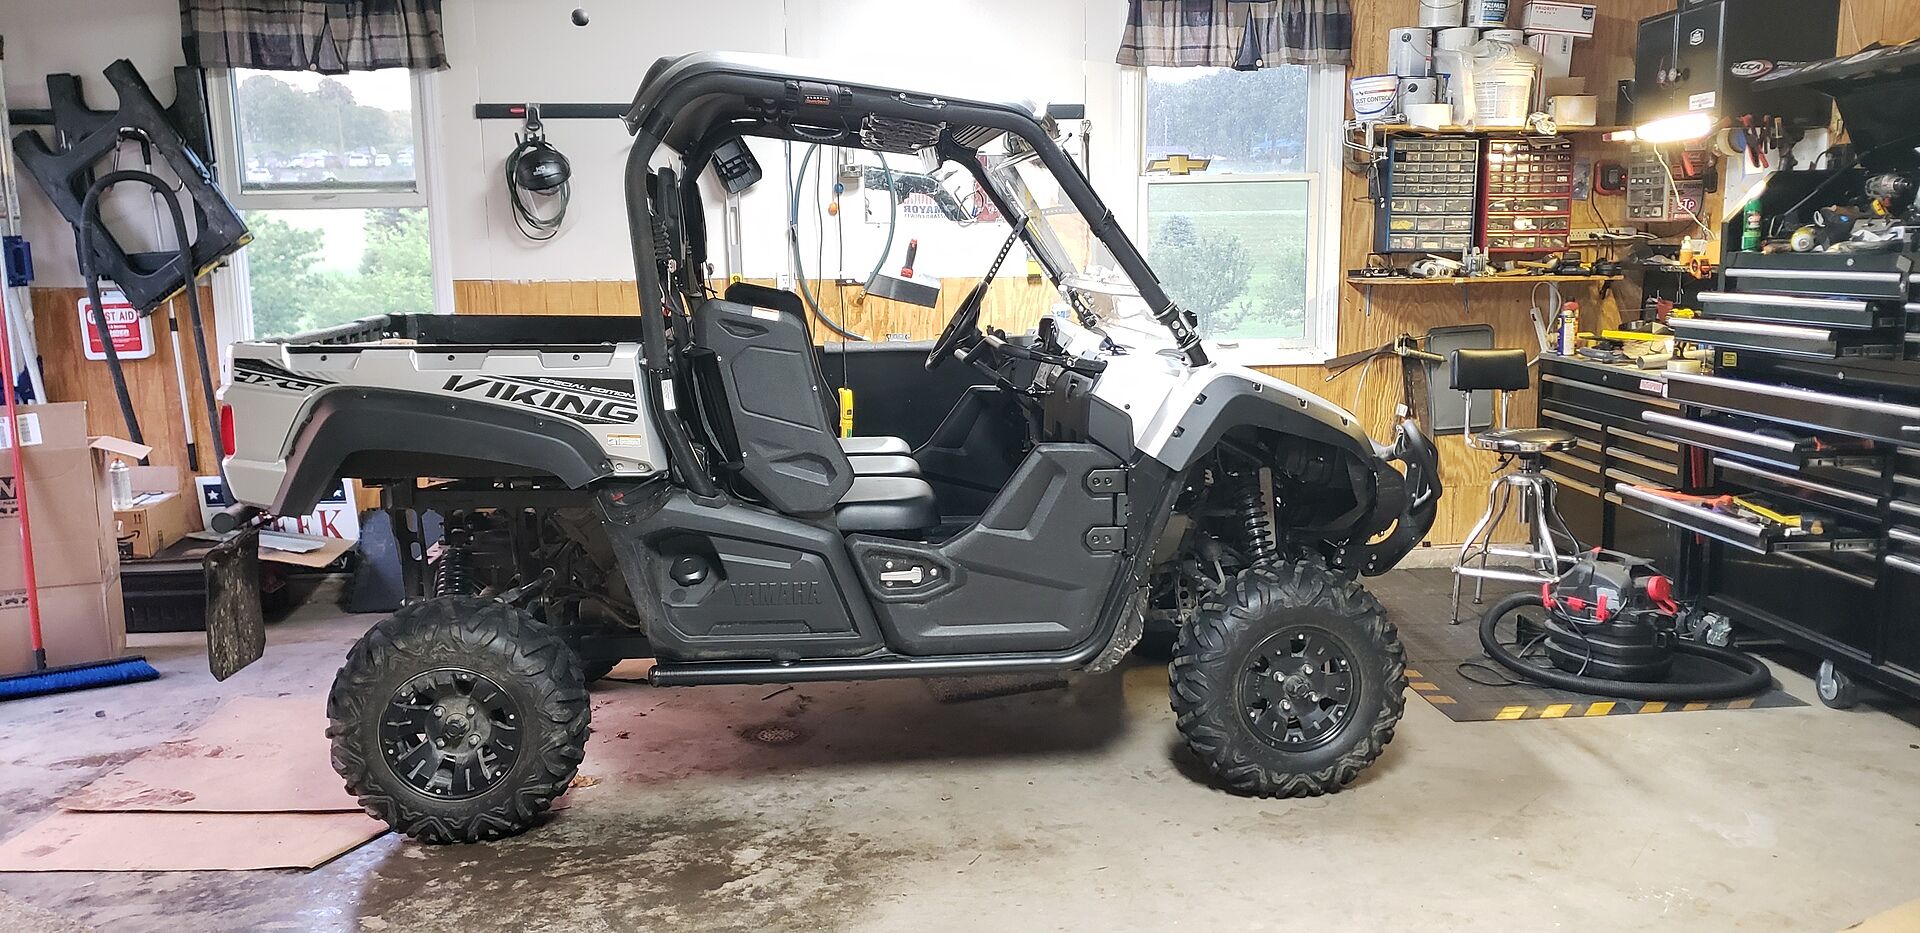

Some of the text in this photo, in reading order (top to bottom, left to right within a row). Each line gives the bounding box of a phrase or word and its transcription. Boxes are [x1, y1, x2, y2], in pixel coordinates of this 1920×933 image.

[1678, 199, 1695, 210] STP
[91, 311, 135, 322] FST AID
[442, 375, 639, 423] VIKING
[539, 378, 635, 399] SPECIAL EDITION
[730, 581, 823, 606] YAMAHA
